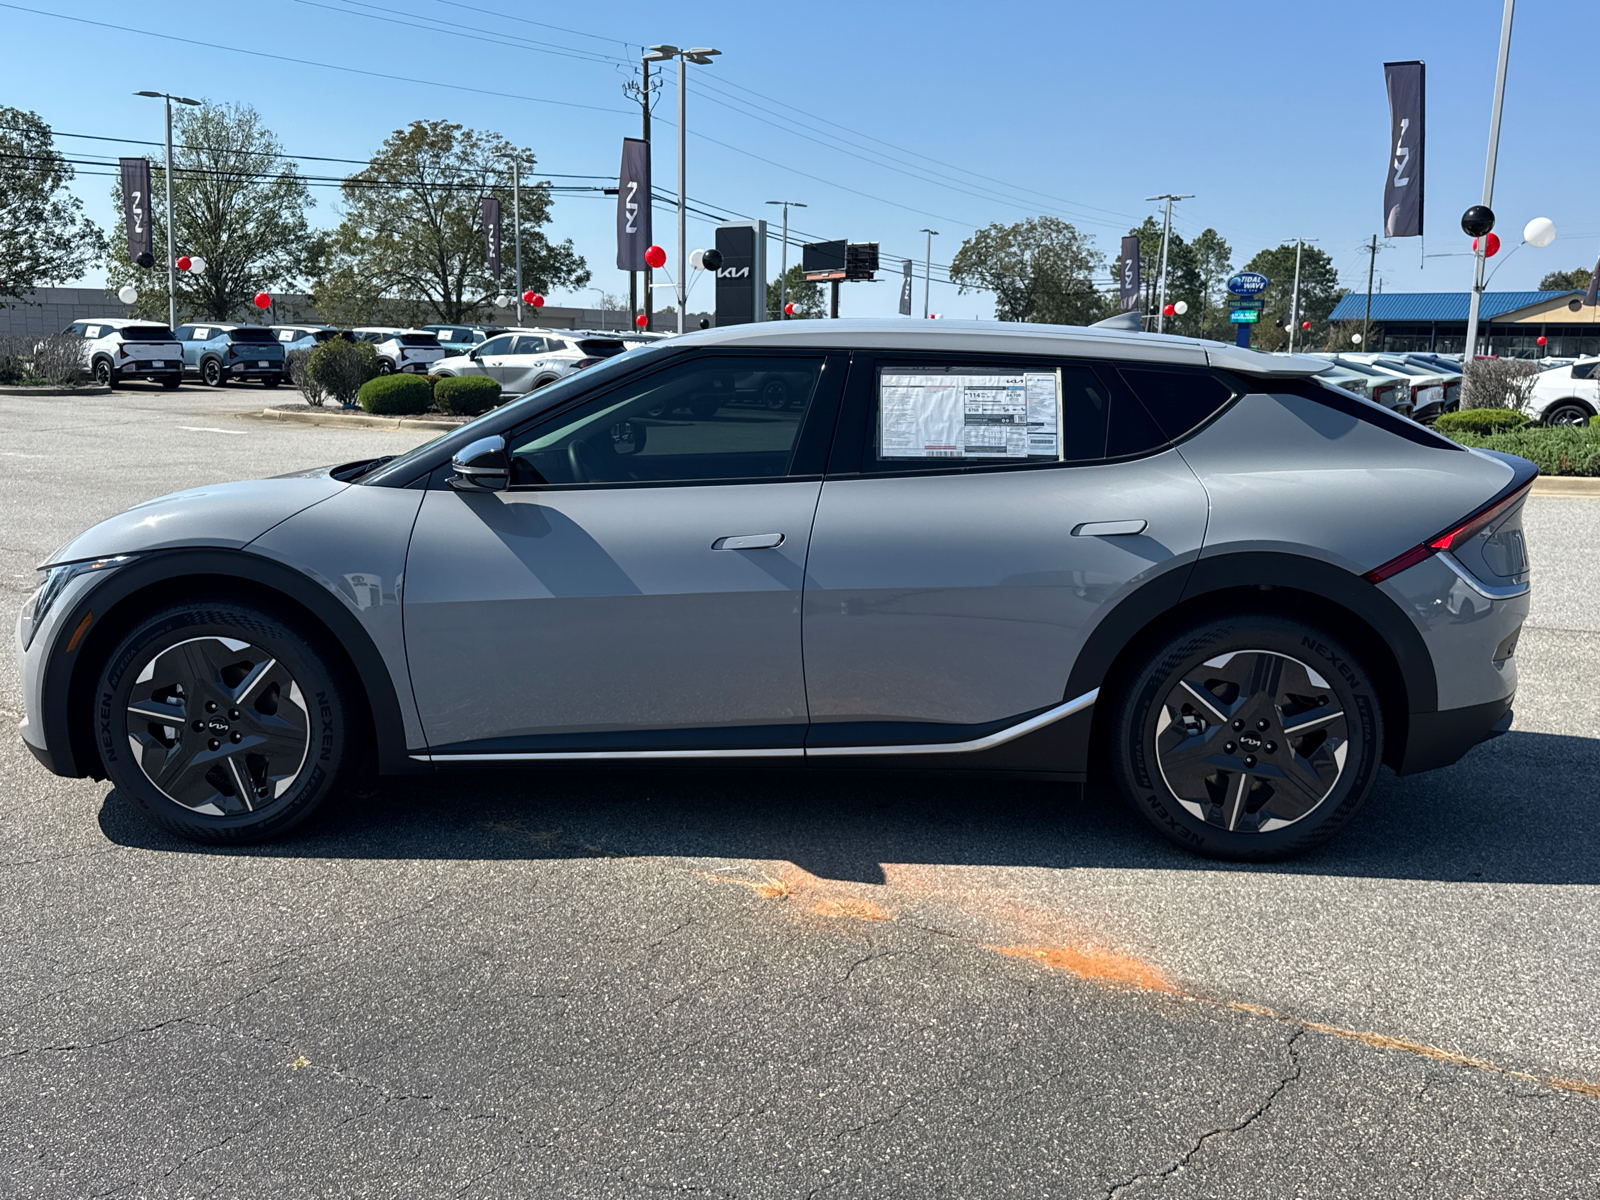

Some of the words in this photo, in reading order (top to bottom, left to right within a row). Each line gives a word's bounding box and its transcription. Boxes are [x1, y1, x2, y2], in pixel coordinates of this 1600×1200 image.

[717, 266, 750, 278] KIA
[1301, 636, 1360, 690] NEXEN
[100, 692, 118, 762] NEXEN
[208, 722, 229, 731] KIA
[316, 691, 333, 761] NEXEN
[1147, 795, 1205, 846] NEXEN
